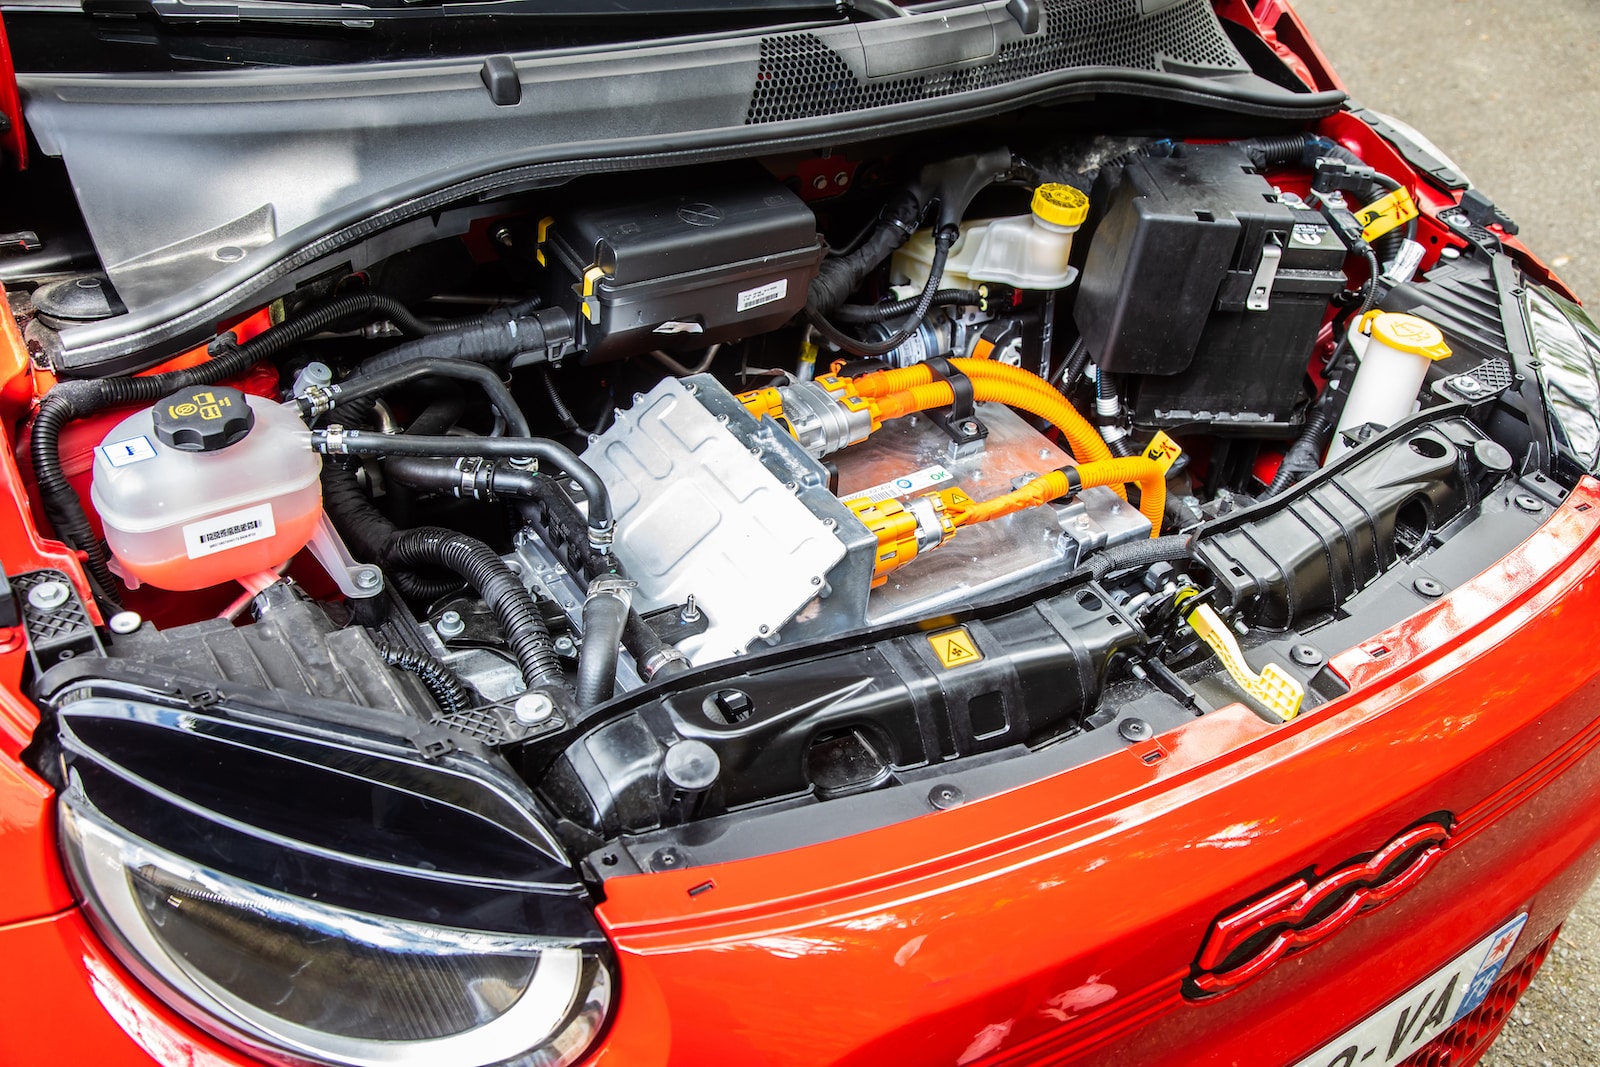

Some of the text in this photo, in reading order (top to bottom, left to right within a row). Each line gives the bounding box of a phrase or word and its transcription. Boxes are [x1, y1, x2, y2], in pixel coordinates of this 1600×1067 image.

[930, 471, 945, 481] OK
[1190, 818, 1452, 994] 500
[1463, 971, 1495, 1009] 78
